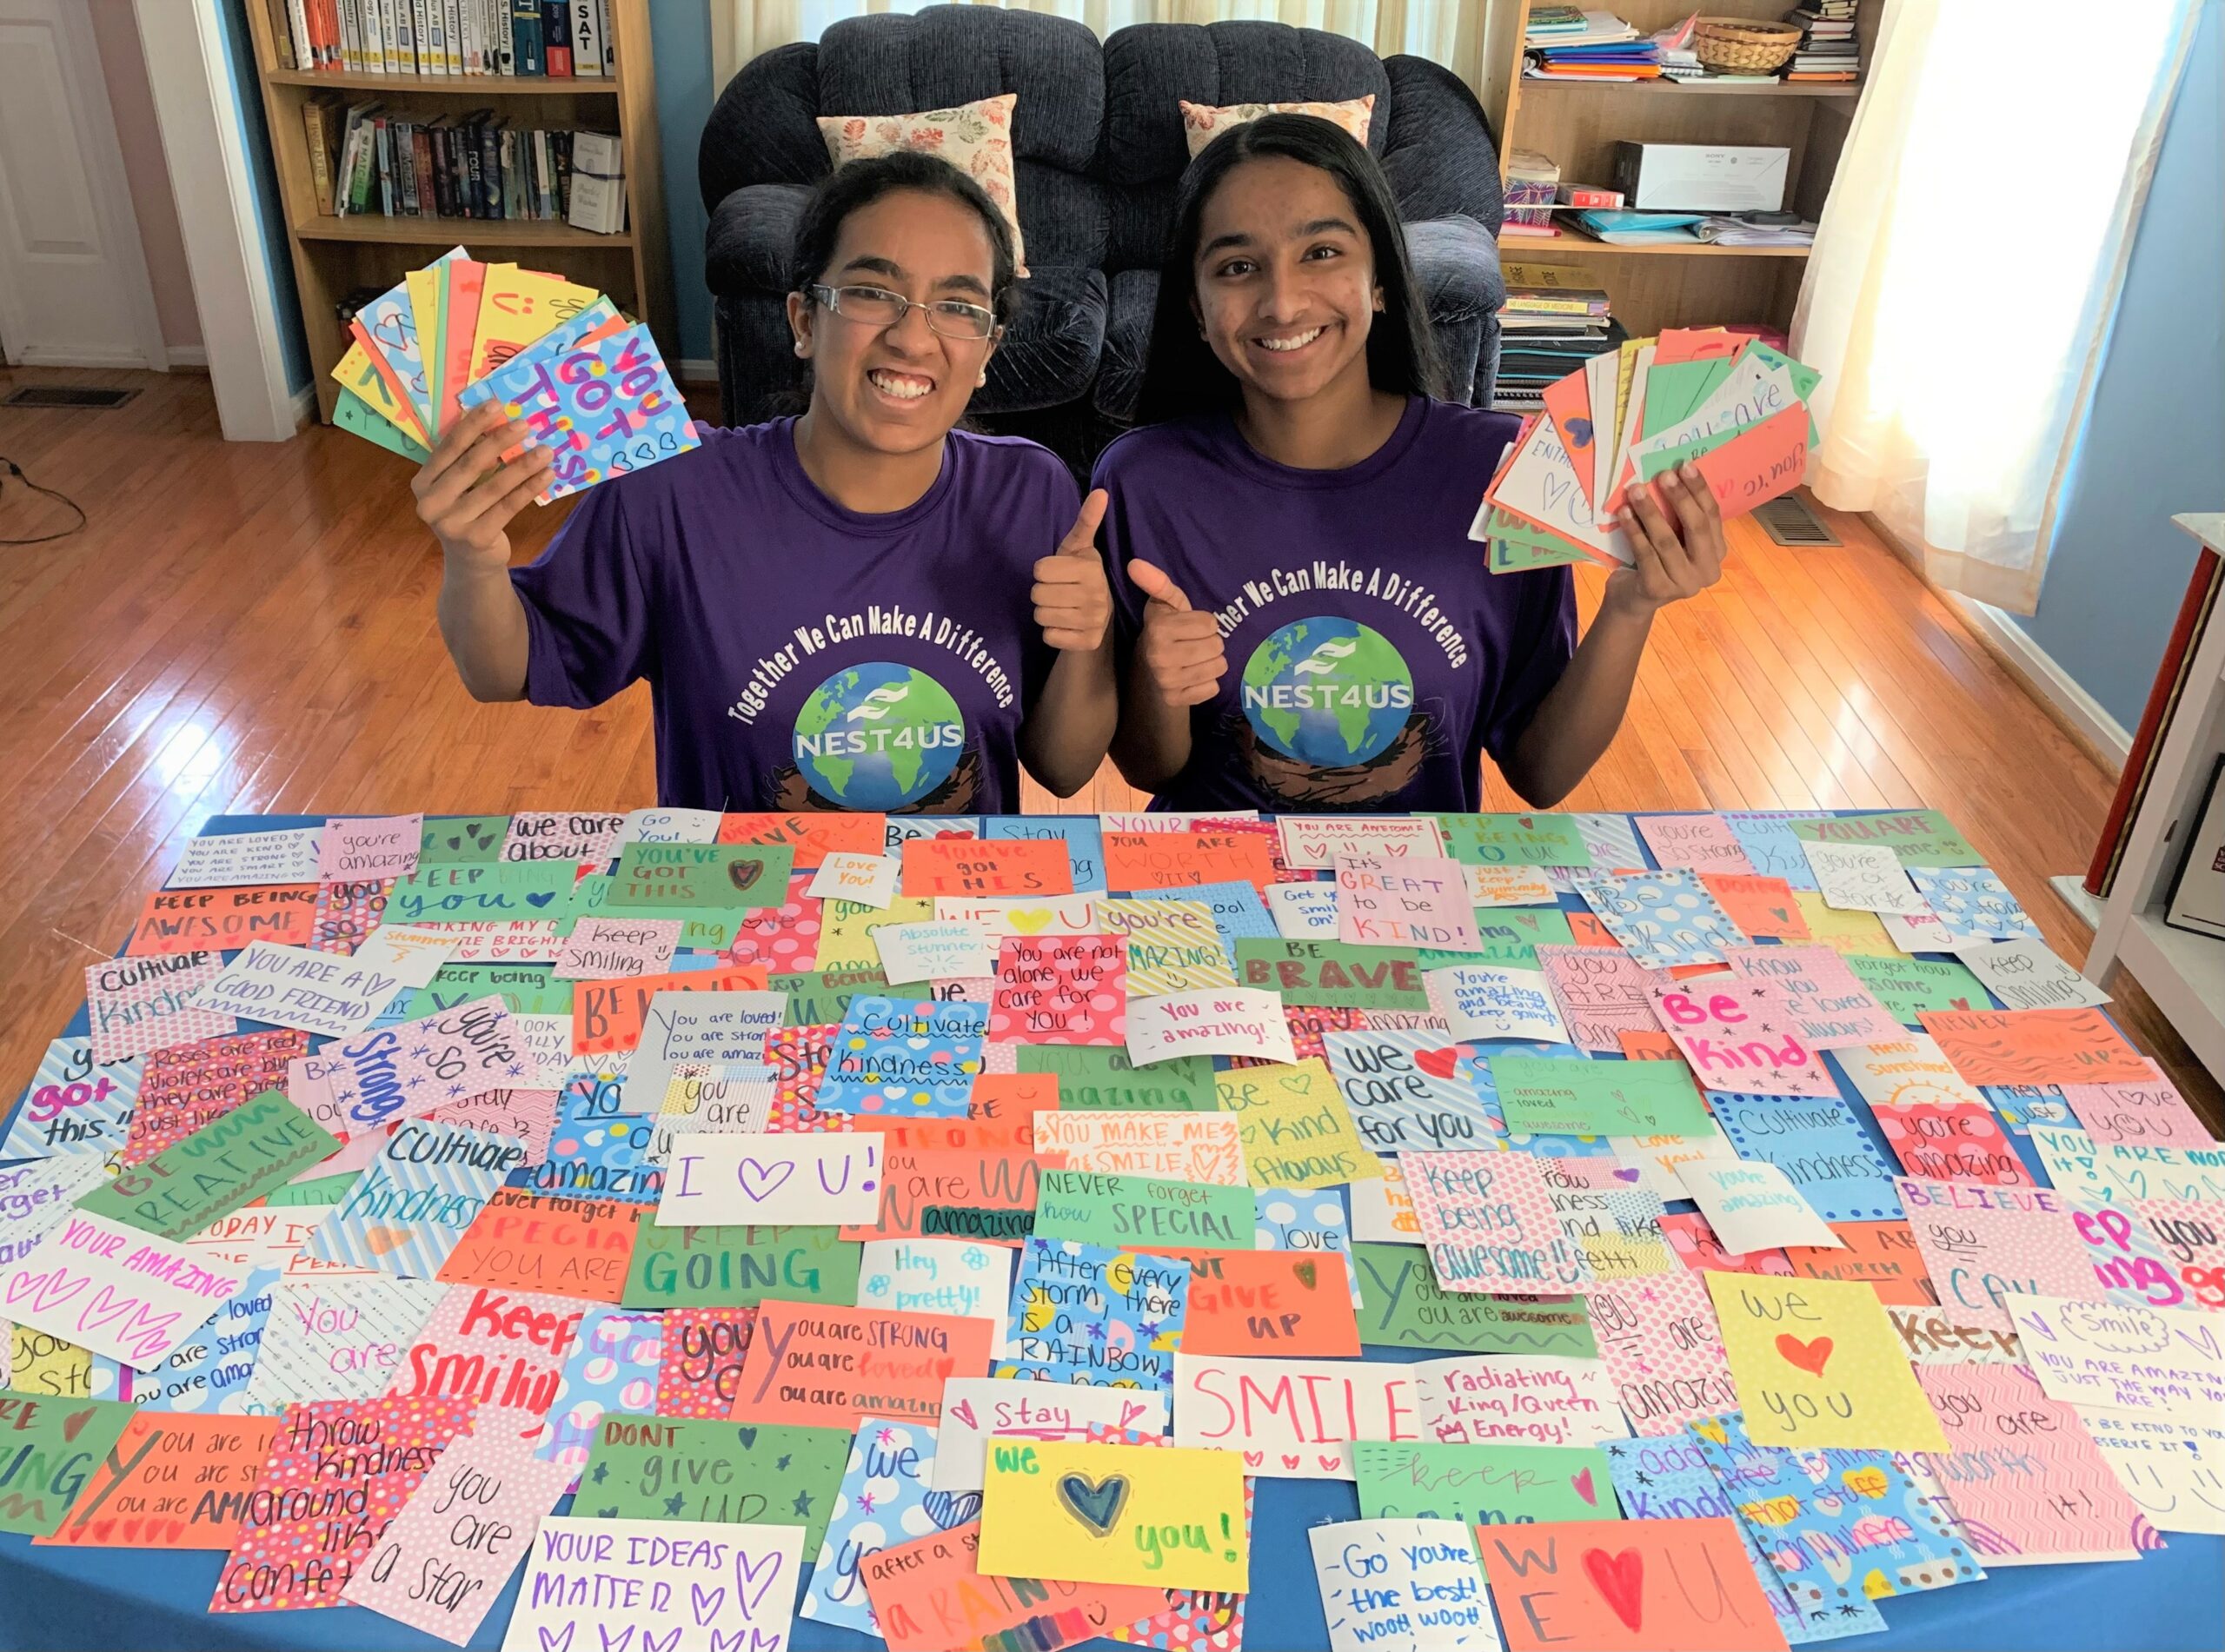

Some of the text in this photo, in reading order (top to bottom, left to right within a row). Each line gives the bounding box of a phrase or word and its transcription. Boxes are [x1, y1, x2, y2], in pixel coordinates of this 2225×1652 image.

[578, 5, 592, 50] SAT
[468, 150, 480, 182] FOUR
[610, 337, 673, 417] YOU
[1243, 581, 1274, 608] We
[1272, 568, 1311, 597] Can
[1312, 561, 1364, 592] Make
[1365, 567, 1381, 598] A
[1381, 573, 1468, 669] Difference
[727, 605, 1016, 726] Together We Can Make A Difference
[1245, 685, 1412, 708] NEST4US
[796, 724, 962, 759] NEST4US
[191, 839, 215, 847] YOU
[249, 834, 289, 844] LOVED
[1293, 822, 1320, 832] YOU
[1325, 822, 1354, 832] ARE
[1804, 815, 1936, 842] YOU ARE
[342, 833, 401, 854] you're
[636, 848, 720, 864] YOU'VE
[1196, 837, 1239, 849] ARE
[632, 866, 697, 879] GOT
[1115, 852, 1253, 871] WORTH
[625, 883, 695, 899] THIS
[933, 872, 1044, 891] THIS
[1340, 870, 1444, 894] GREAT
[233, 890, 318, 906] BEING
[1353, 895, 1433, 912] to be
[139, 911, 302, 941] AWESOME
[1107, 909, 1202, 937] you're
[1352, 917, 1467, 945] KIND!
[1012, 943, 1124, 963] You are not
[1286, 942, 1325, 959] BE
[247, 948, 364, 990] YOU ARE A
[1004, 965, 1063, 985] alone,
[1245, 959, 1424, 992] BRAVE
[214, 973, 369, 1019] GOOD FRIEND
[1212, 1000, 1247, 1014] are
[1662, 993, 1748, 1025] Be
[863, 1012, 985, 1034] Cultivate
[154, 1049, 212, 1069] Roses
[220, 1041, 255, 1056] are
[149, 1063, 253, 1091] Violets are
[28, 1076, 118, 1122] got
[141, 1081, 238, 1111] they are
[684, 1078, 727, 1113] you
[1513, 1087, 1577, 1101] amazing
[1517, 1098, 1556, 1110] loved
[707, 1098, 750, 1124] are
[1046, 1115, 1219, 1144] YOU MAKE ME
[675, 1155, 706, 1198] I
[1097, 1151, 1183, 1173] SMILE
[1903, 1151, 2022, 1185] amazing
[112, 1157, 183, 1198] BE
[1046, 1172, 1125, 1197] NEVER
[1900, 1181, 2059, 1215] BELIEVE
[1042, 1201, 1242, 1243] how SPECIAL
[1438, 1202, 1524, 1243] being
[58, 1218, 239, 1298] YOUR AMAZING
[472, 1247, 624, 1281] YOU ARE
[644, 1248, 821, 1296] GOING
[894, 1244, 938, 1281] Hey
[1037, 1248, 1183, 1294] After every
[894, 1284, 980, 1317] pretty!
[1190, 1284, 1283, 1314] GIVE
[1019, 1307, 1074, 1334] is a
[832, 1319, 948, 1353] are STRONG
[330, 1343, 399, 1374] are
[818, 1352, 854, 1371] are
[1020, 1337, 1160, 1375] RAINBOW
[2108, 1376, 2142, 1392] THE
[2148, 1385, 2191, 1401] WAY
[1193, 1369, 1418, 1443] SMILE
[1761, 1390, 1853, 1432] you
[605, 1421, 685, 1448] DONT
[1474, 1415, 1573, 1446] Energy!
[1996, 1410, 2058, 1436] are
[434, 1463, 502, 1514] you
[639, 1455, 734, 1497] give
[250, 1479, 369, 1527] around
[450, 1514, 512, 1554] are
[1773, 1516, 1918, 1573] anywhere
[541, 1529, 730, 1570] YOUR IDEAS
[531, 1571, 671, 1613] MATTER
